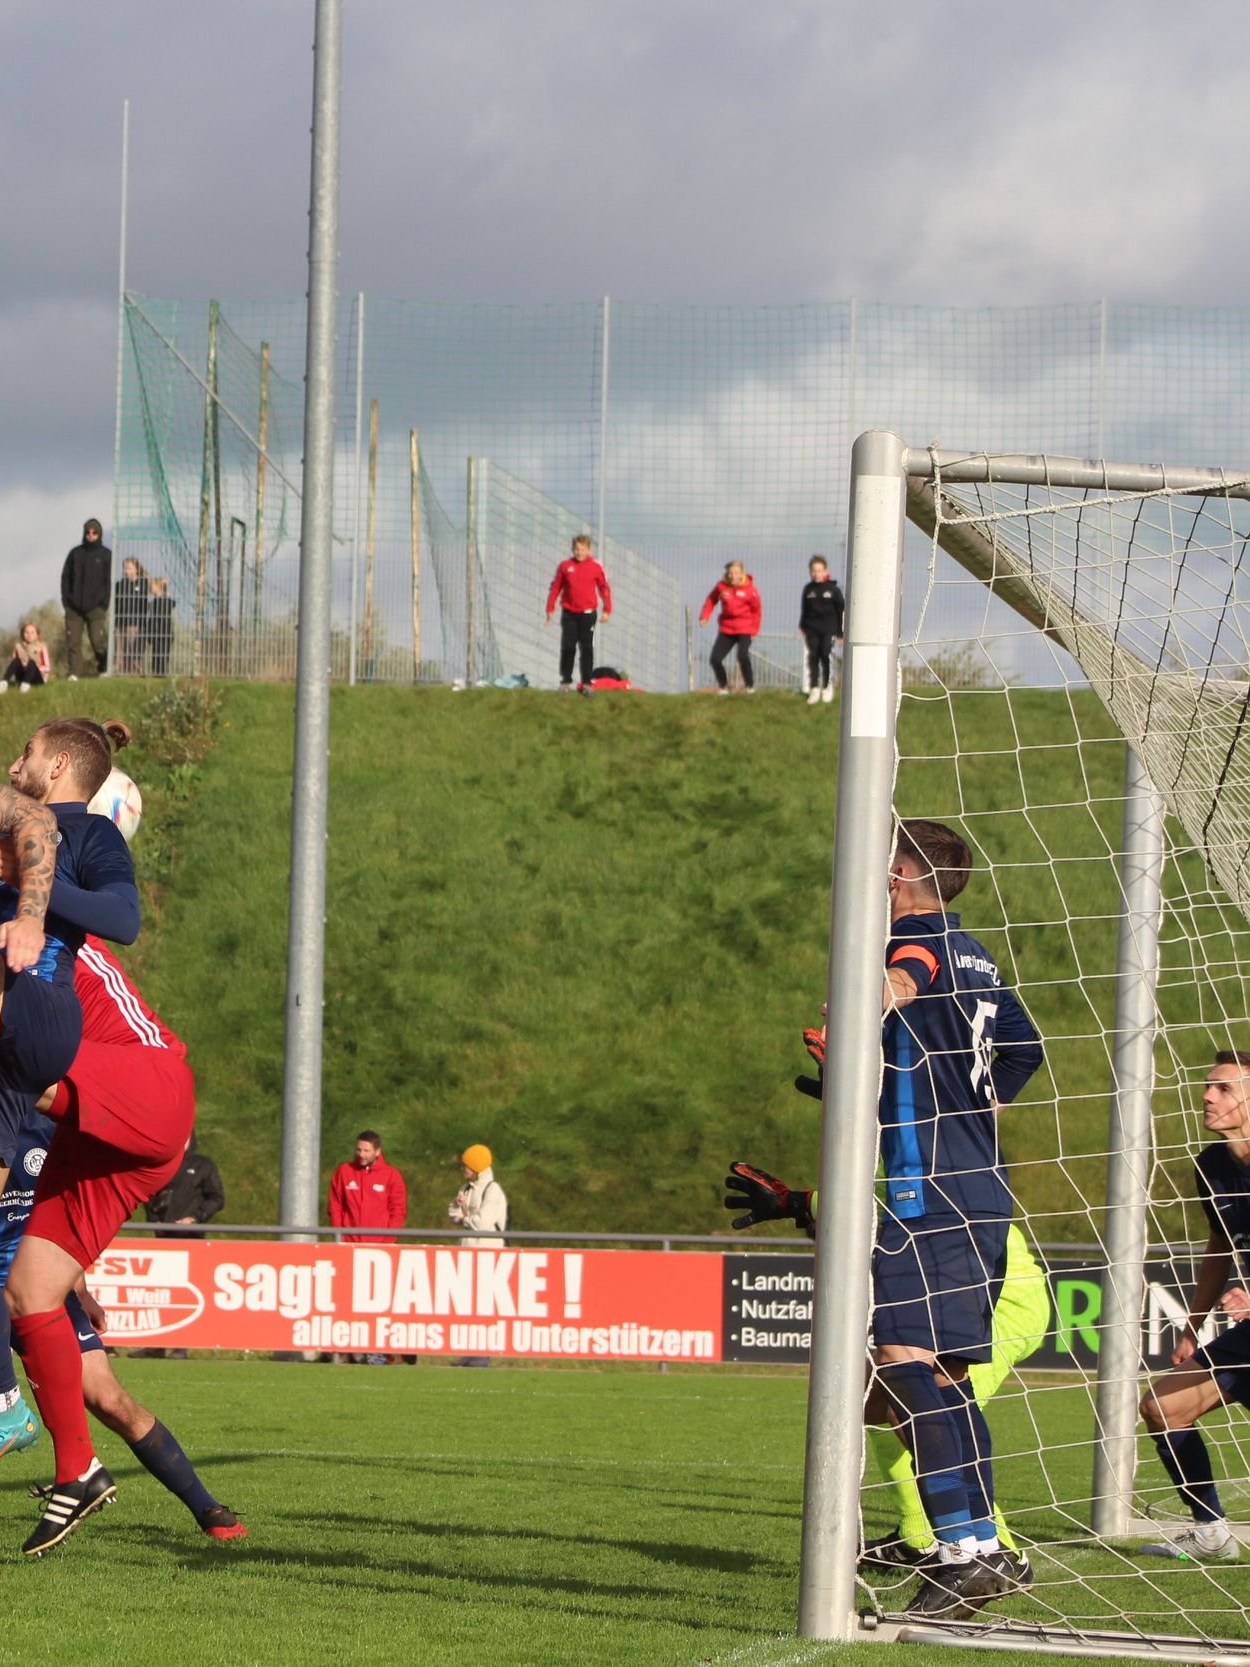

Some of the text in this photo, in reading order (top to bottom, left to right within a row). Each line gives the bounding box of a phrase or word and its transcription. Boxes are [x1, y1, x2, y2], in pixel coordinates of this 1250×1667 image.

[213, 1259, 336, 1319] sagt
[351, 1247, 549, 1318] DANKE
[105, 1308, 162, 1331] NZLAU
[292, 1315, 714, 1358] allen Fans und Unterstützern
